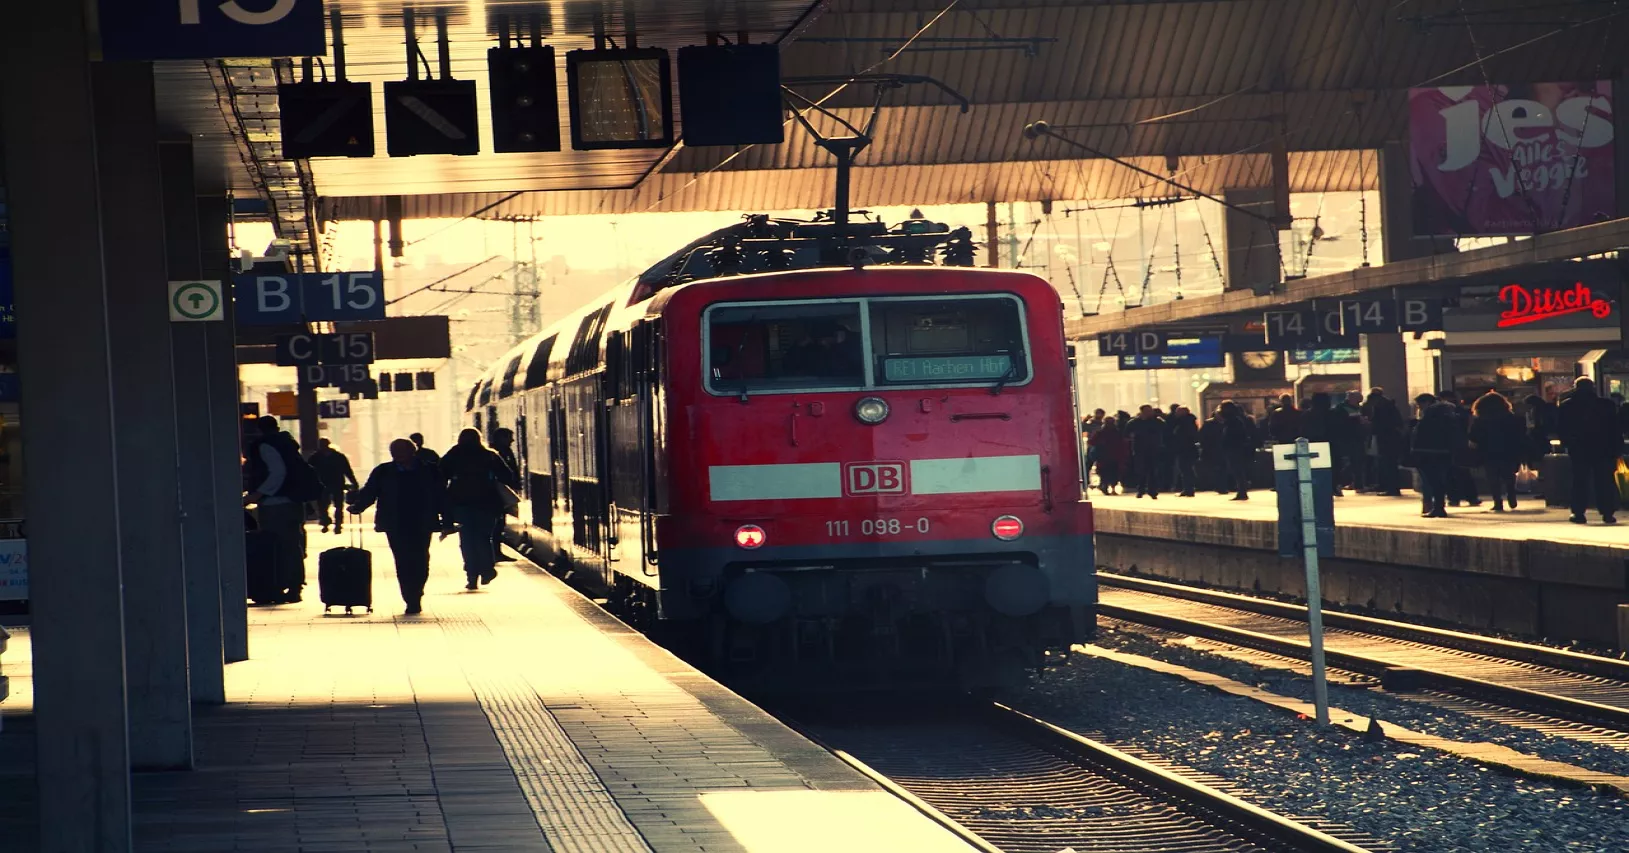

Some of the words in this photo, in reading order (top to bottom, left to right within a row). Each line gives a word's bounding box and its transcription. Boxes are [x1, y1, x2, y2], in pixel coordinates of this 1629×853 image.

[1437, 87, 1614, 172] jes
[256, 276, 291, 313] B
[321, 272, 376, 310] 15
[1499, 282, 1593, 320] Ditsch
[1271, 312, 1305, 337] 14
[1347, 300, 1385, 327] 14
[1404, 300, 1429, 326] B
[288, 334, 312, 360] C
[332, 333, 369, 358] 15
[1101, 333, 1128, 352] 14
[1141, 332, 1159, 351] D
[307, 365, 324, 383] D
[340, 363, 367, 382] 15
[893, 360, 916, 377] RE1
[922, 359, 974, 375] Aachen
[980, 357, 1005, 373] Hbf
[326, 401, 348, 415] 15
[853, 466, 900, 491] DB
[826, 520, 849, 537] 111
